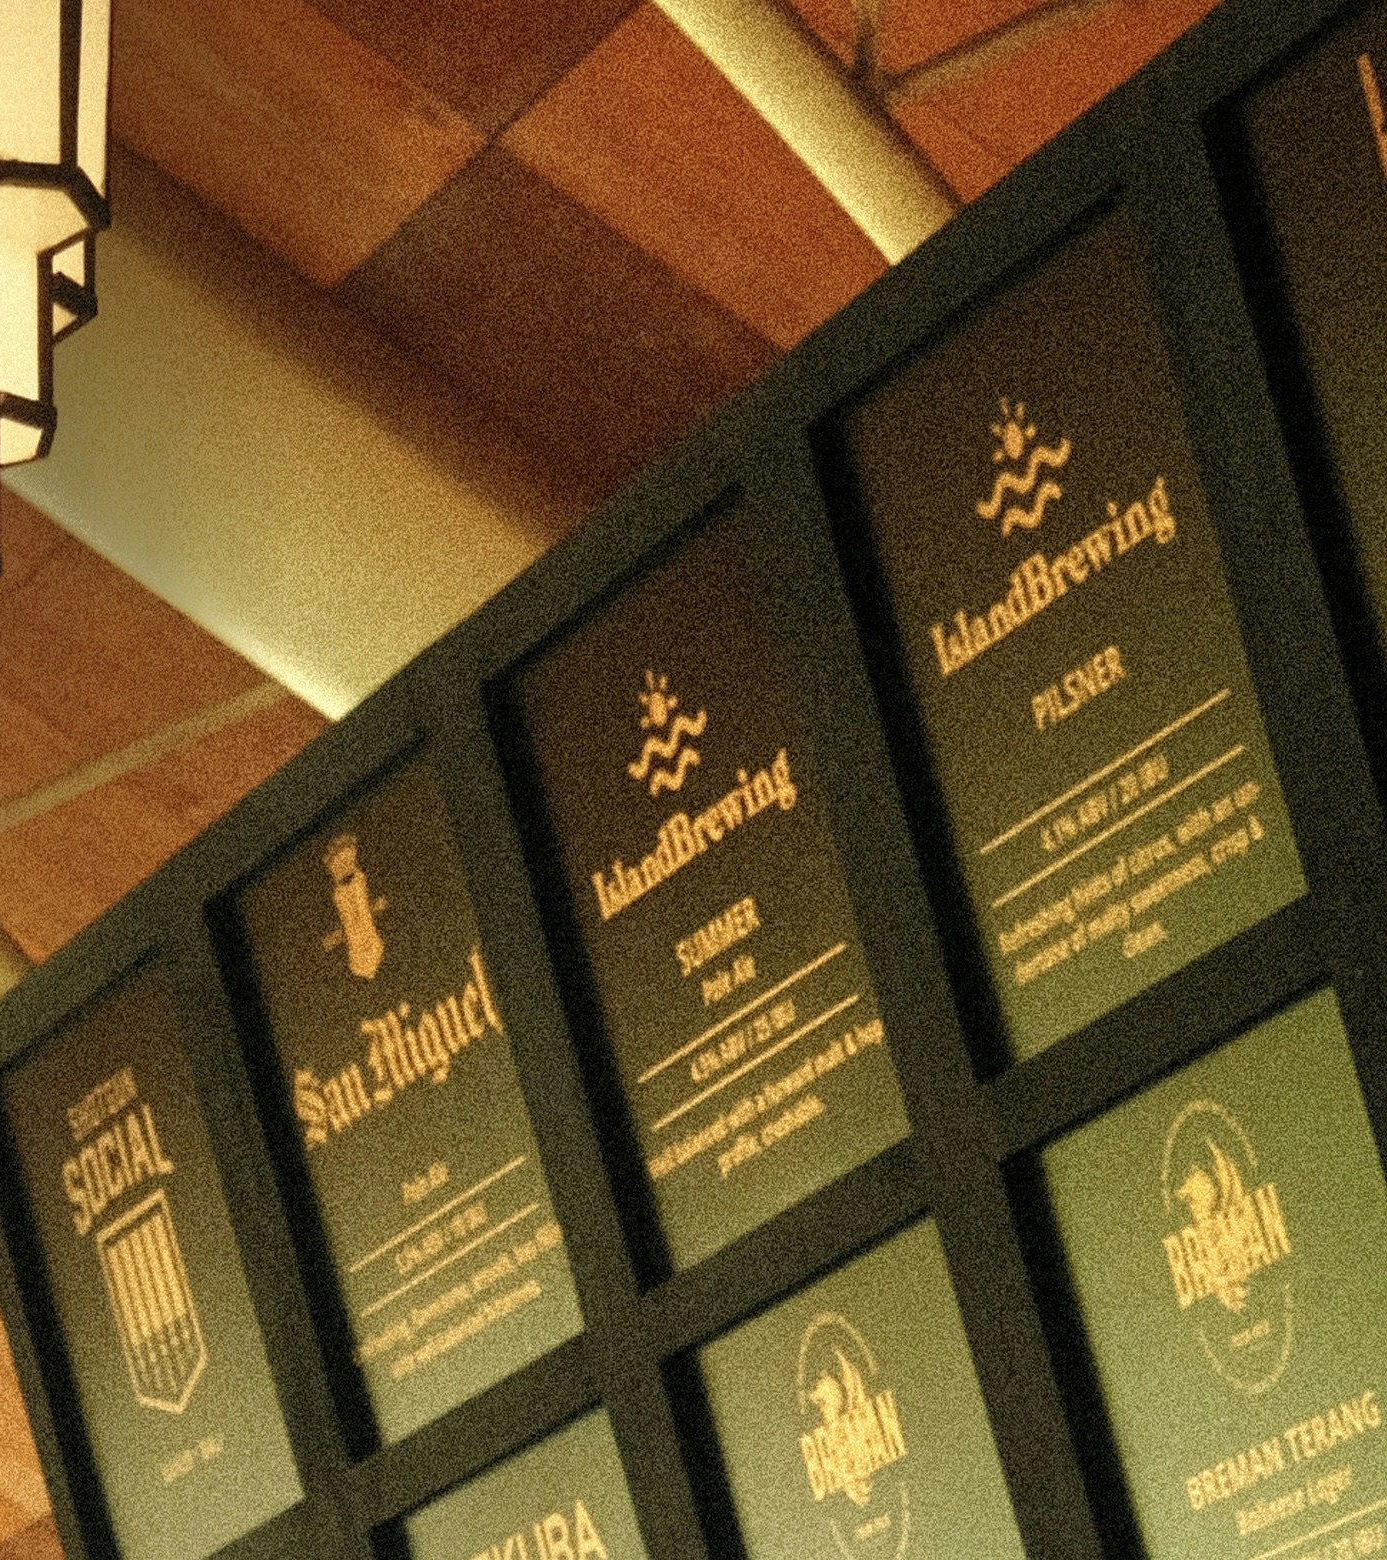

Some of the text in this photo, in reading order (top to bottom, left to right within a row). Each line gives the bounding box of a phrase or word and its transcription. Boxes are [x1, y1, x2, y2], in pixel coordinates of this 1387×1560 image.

[932, 480, 1174, 673] IslandBrewing
[1031, 646, 1124, 728] PILSNER
[593, 752, 795, 917] IslandBrewing
[676, 897, 759, 975] SUMMER
[295, 953, 501, 1144] San Miguel
[63, 1106, 173, 1234] SOCIAL
[1186, 1391, 1380, 1509] BREMAN TERANG
